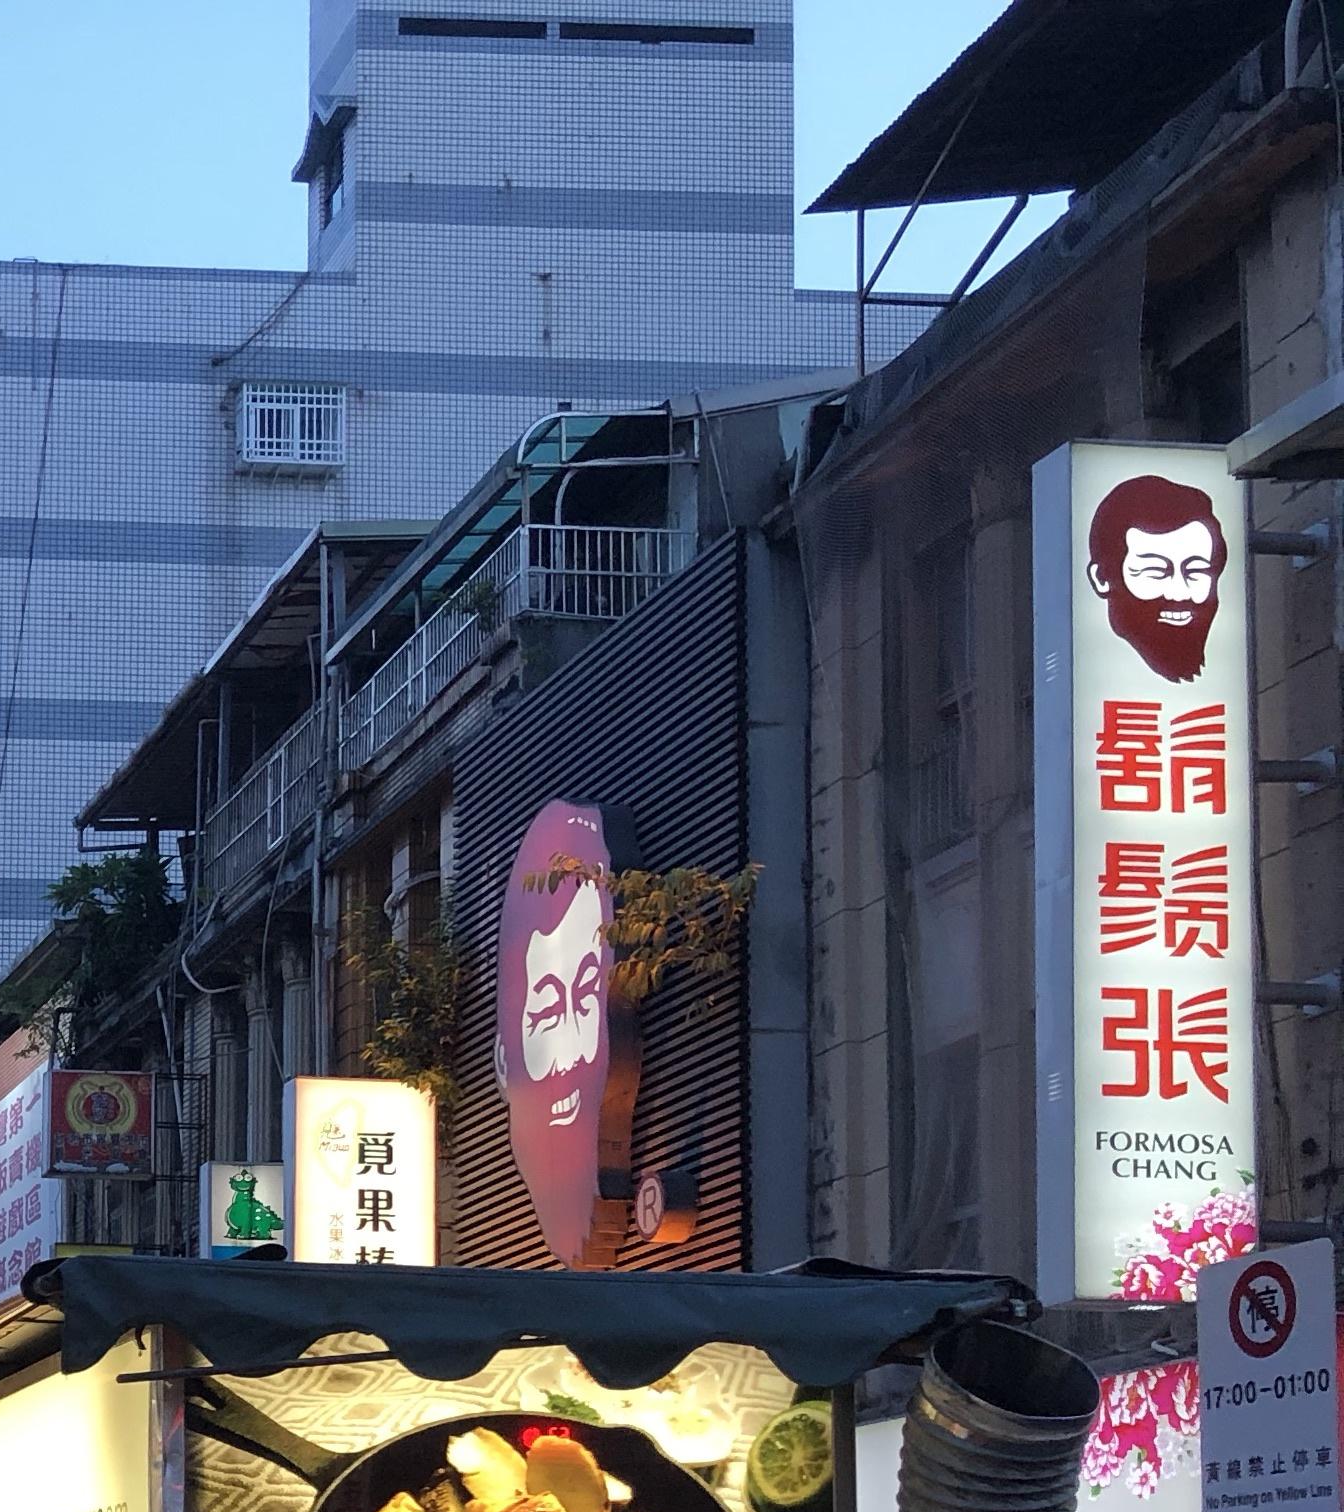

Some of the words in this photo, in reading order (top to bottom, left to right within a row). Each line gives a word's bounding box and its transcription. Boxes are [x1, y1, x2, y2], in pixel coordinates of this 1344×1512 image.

[1095, 1131, 1235, 1156] FORMOSA
[1112, 1157, 1218, 1182] CHANG
[1204, 1368, 1330, 1410] 17:00-01:00
[1221, 1493, 1259, 1508] Parking
[1275, 1486, 1308, 1502] Yellow
